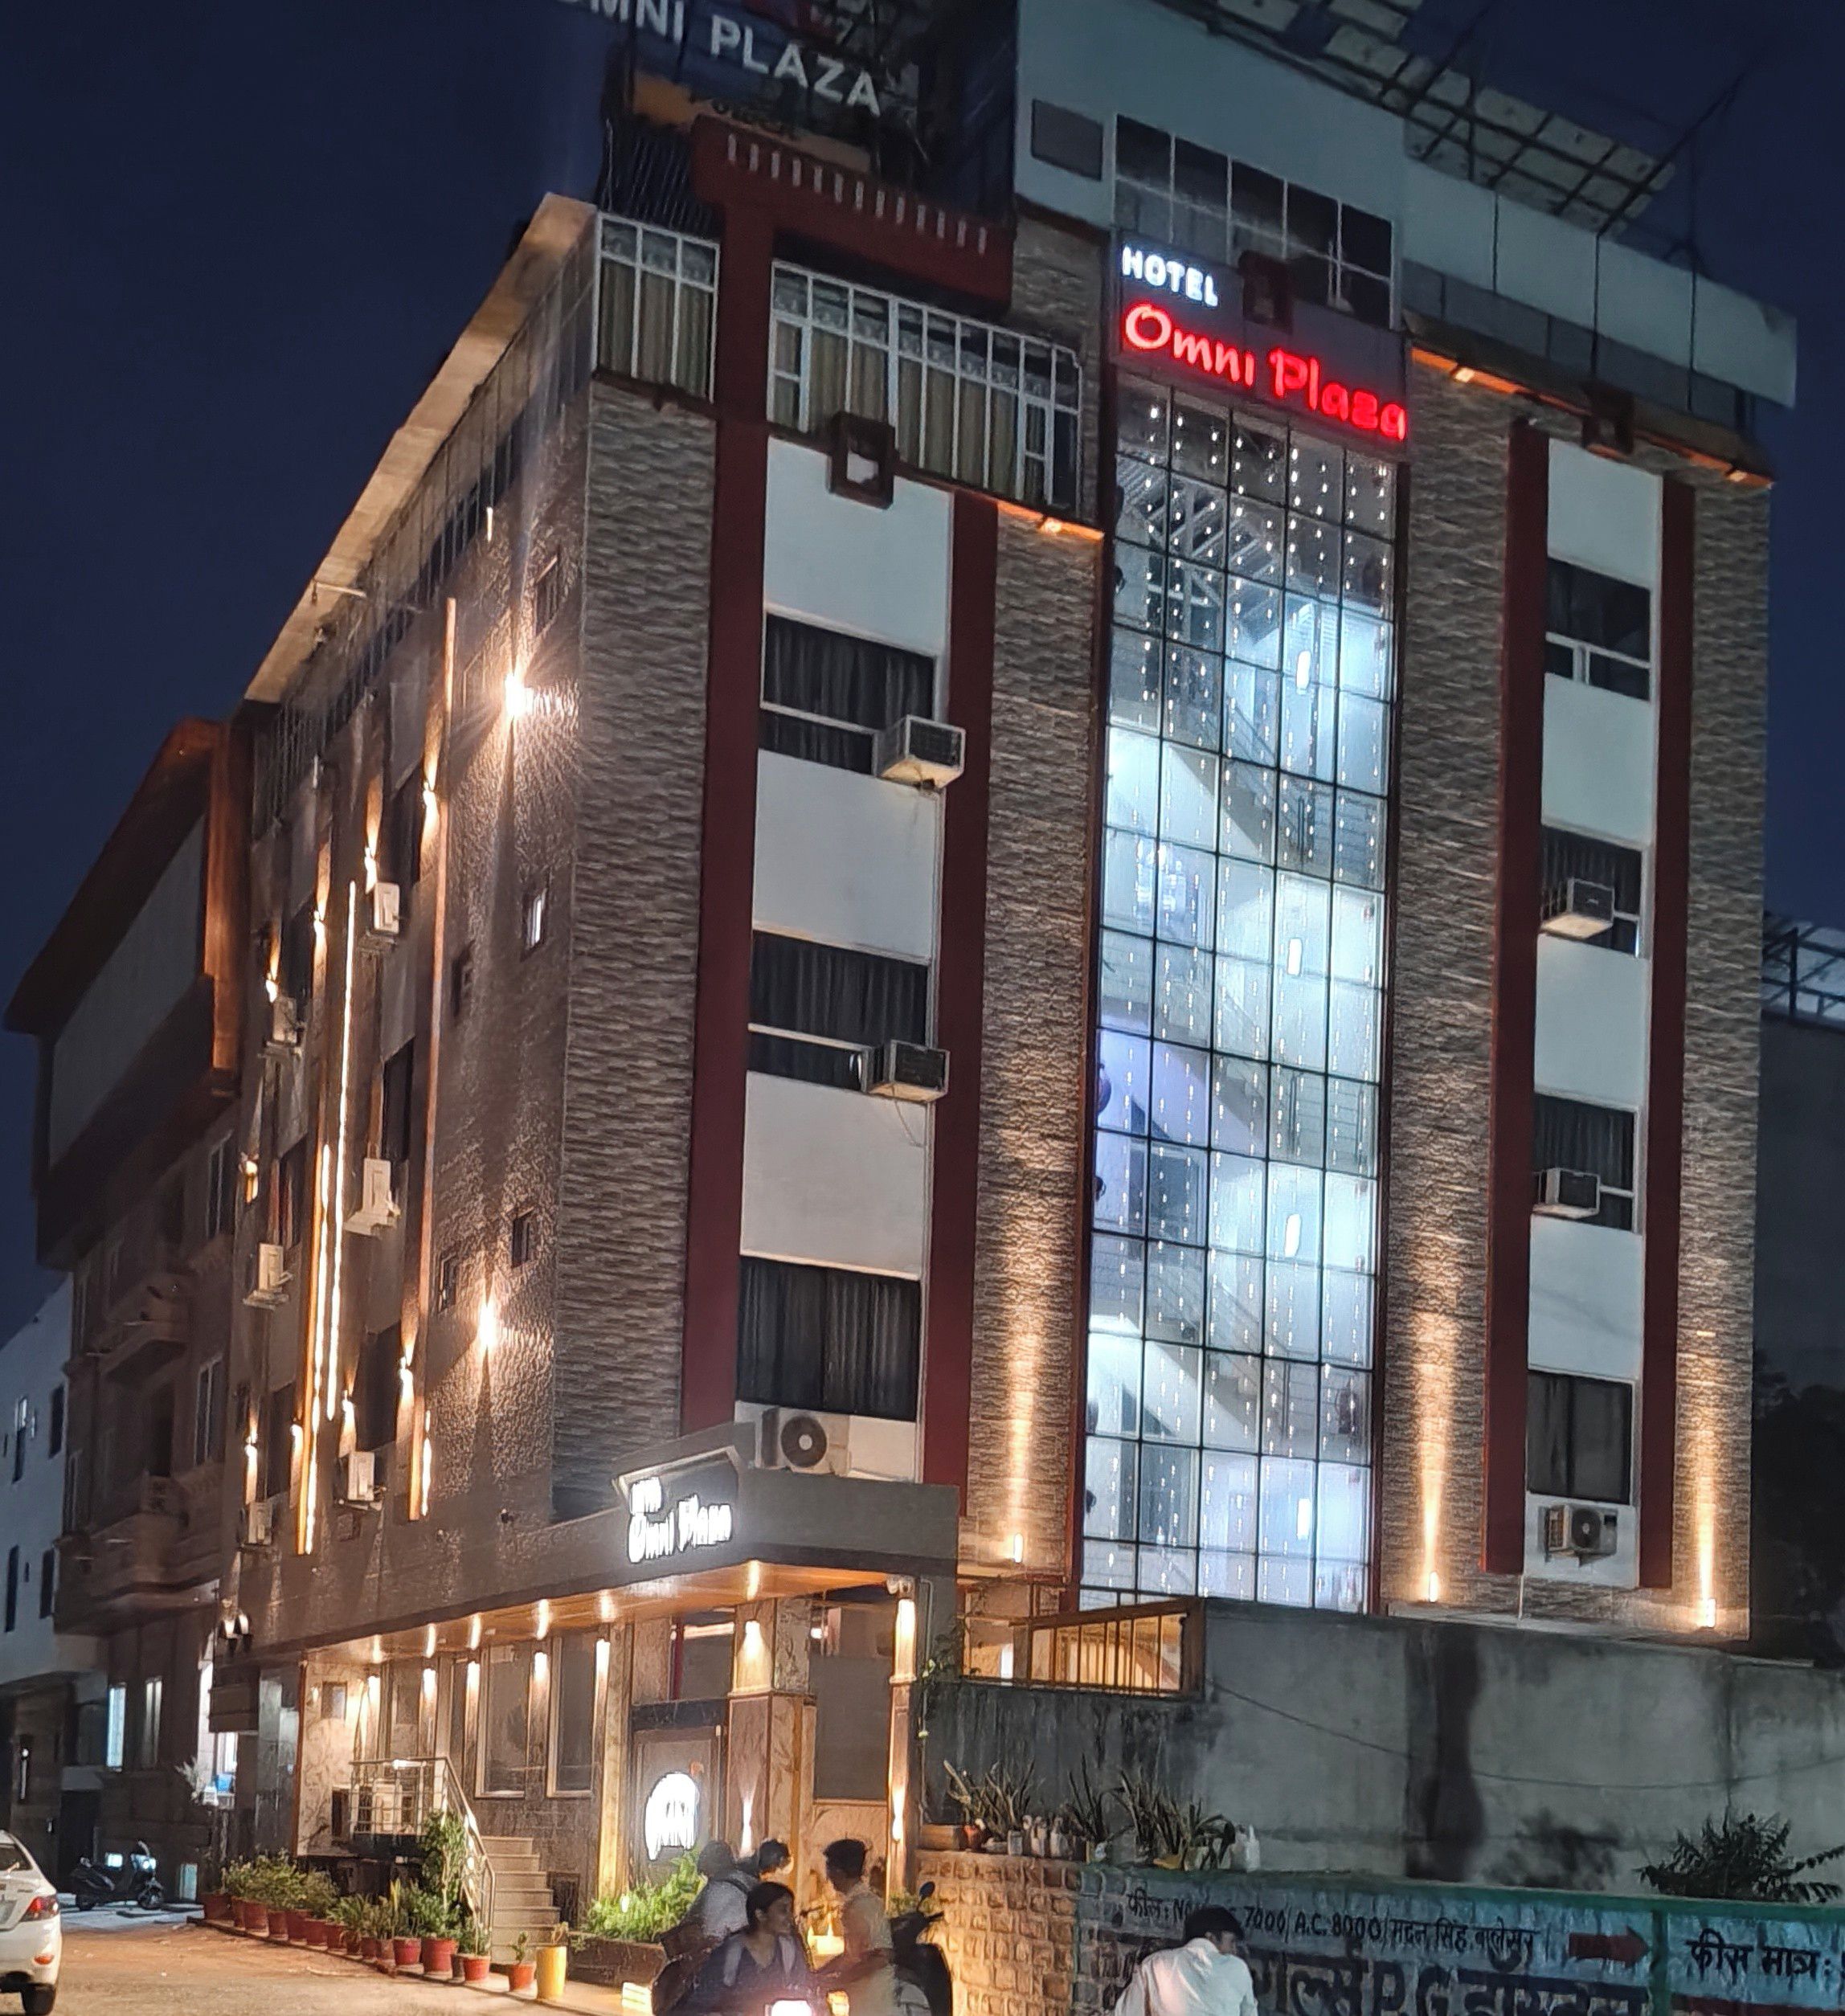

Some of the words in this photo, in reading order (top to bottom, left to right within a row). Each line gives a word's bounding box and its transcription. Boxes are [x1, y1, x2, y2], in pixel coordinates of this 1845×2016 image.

[565, 0, 685, 43] NI
[710, 14, 882, 117] PLAZA
[1122, 244, 1218, 307] HOTEL
[1125, 304, 1256, 387] Omni
[1270, 349, 1406, 441] Plaza
